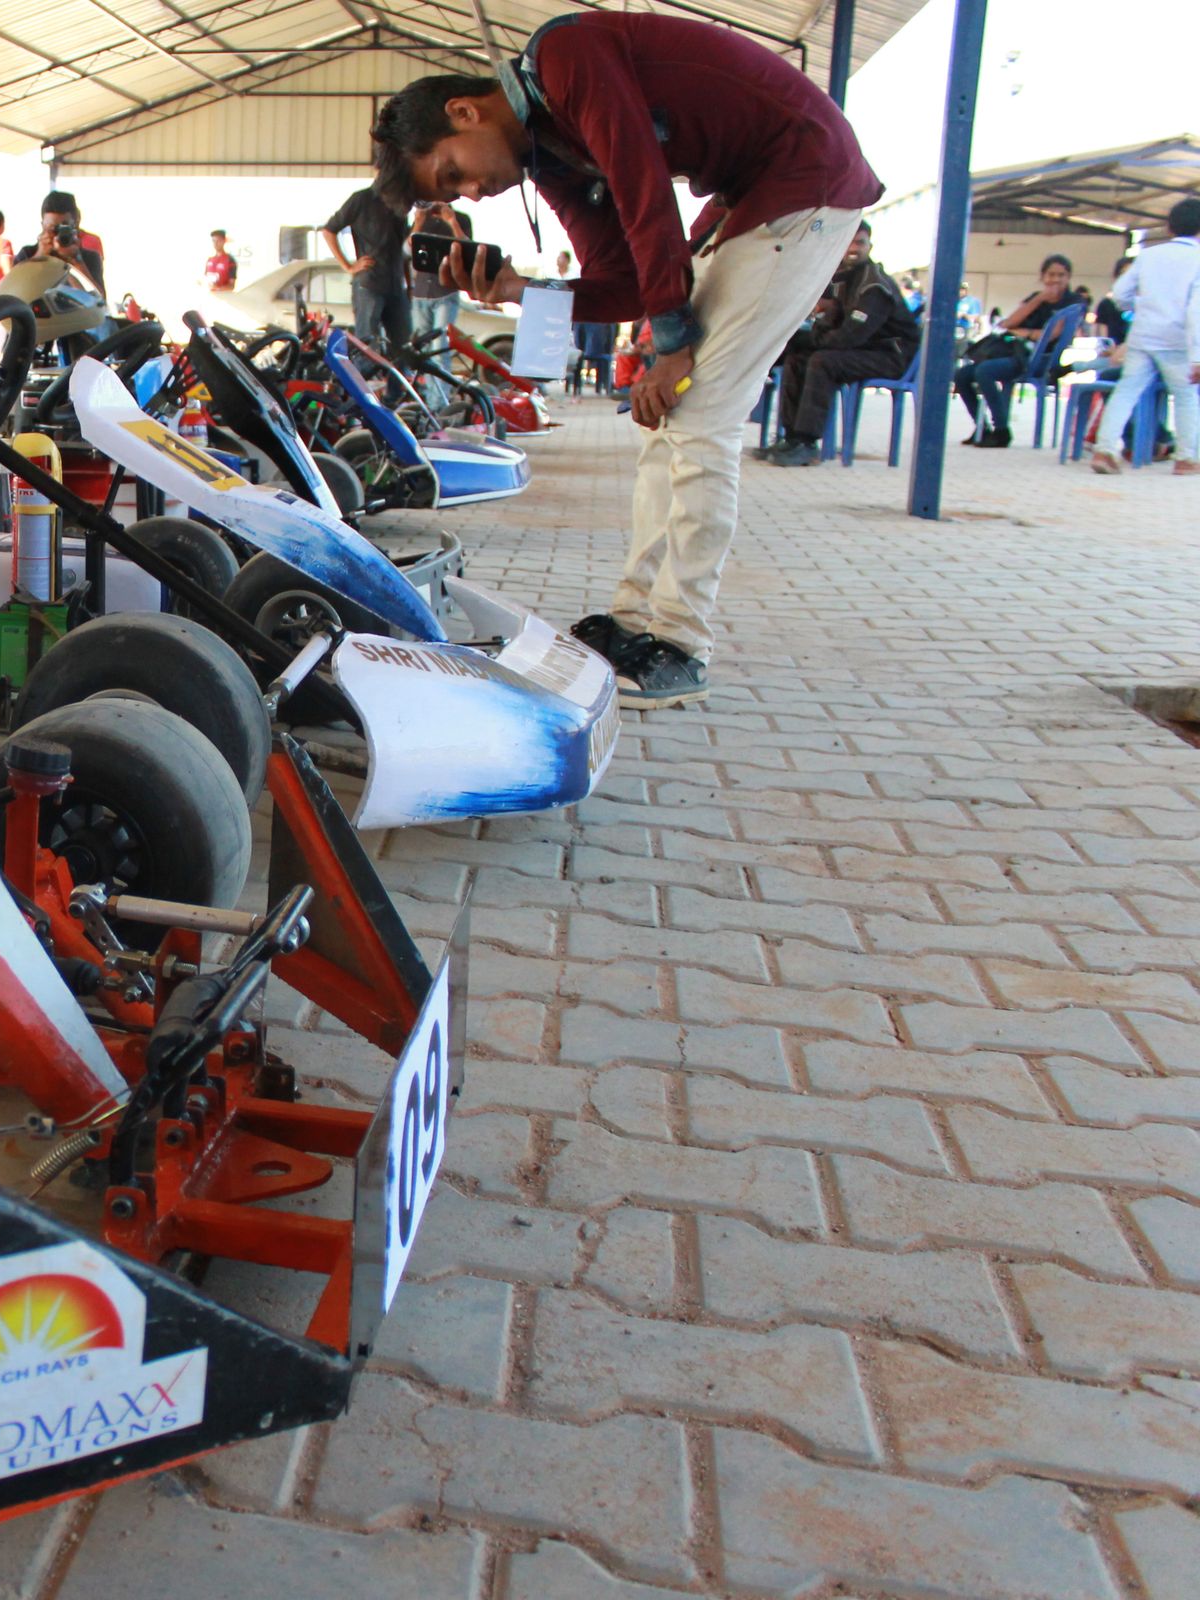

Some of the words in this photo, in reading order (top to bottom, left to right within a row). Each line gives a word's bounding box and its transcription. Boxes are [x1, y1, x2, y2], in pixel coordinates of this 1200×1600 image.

[351, 641, 431, 673] SHRI
[399, 1019, 441, 1248] 09
[36, 1353, 90, 1378] RAYS
